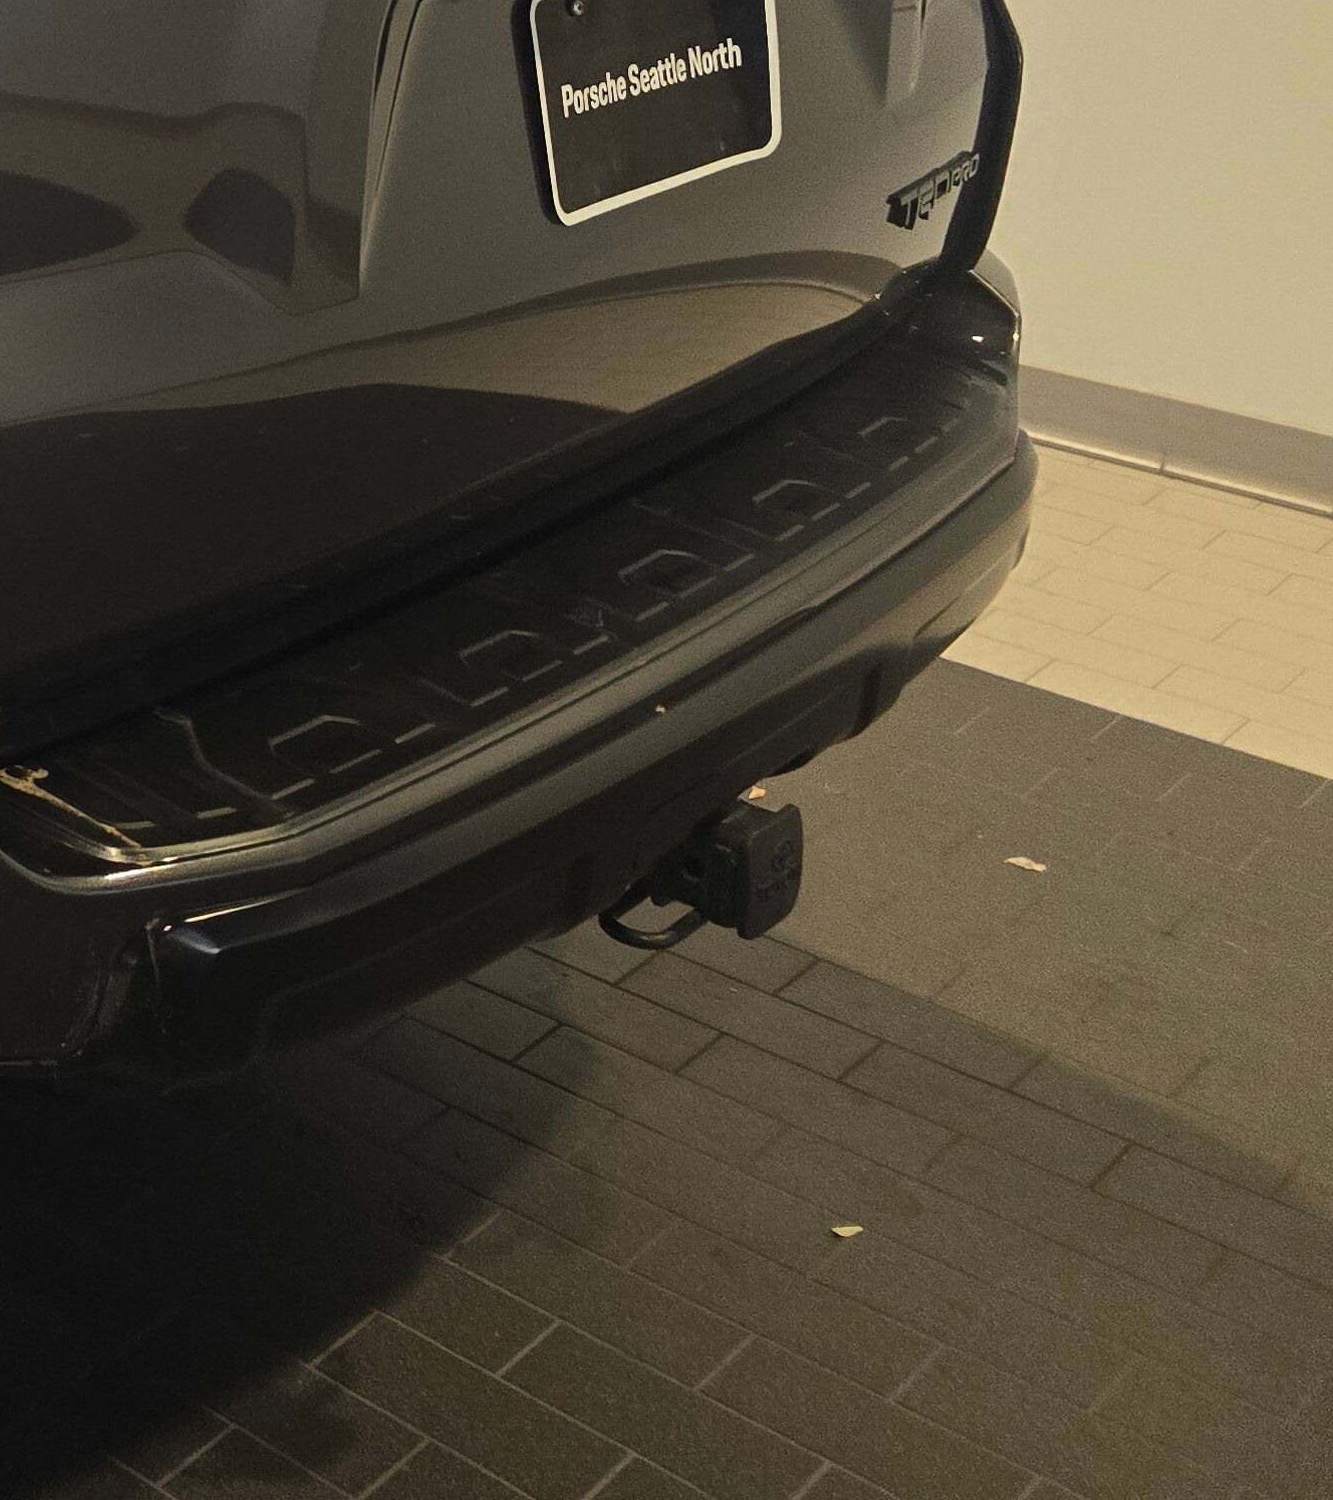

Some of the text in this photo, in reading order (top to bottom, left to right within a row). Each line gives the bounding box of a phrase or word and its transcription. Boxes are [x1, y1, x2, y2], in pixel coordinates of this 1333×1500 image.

[561, 37, 743, 118] Porsche Seattle North
